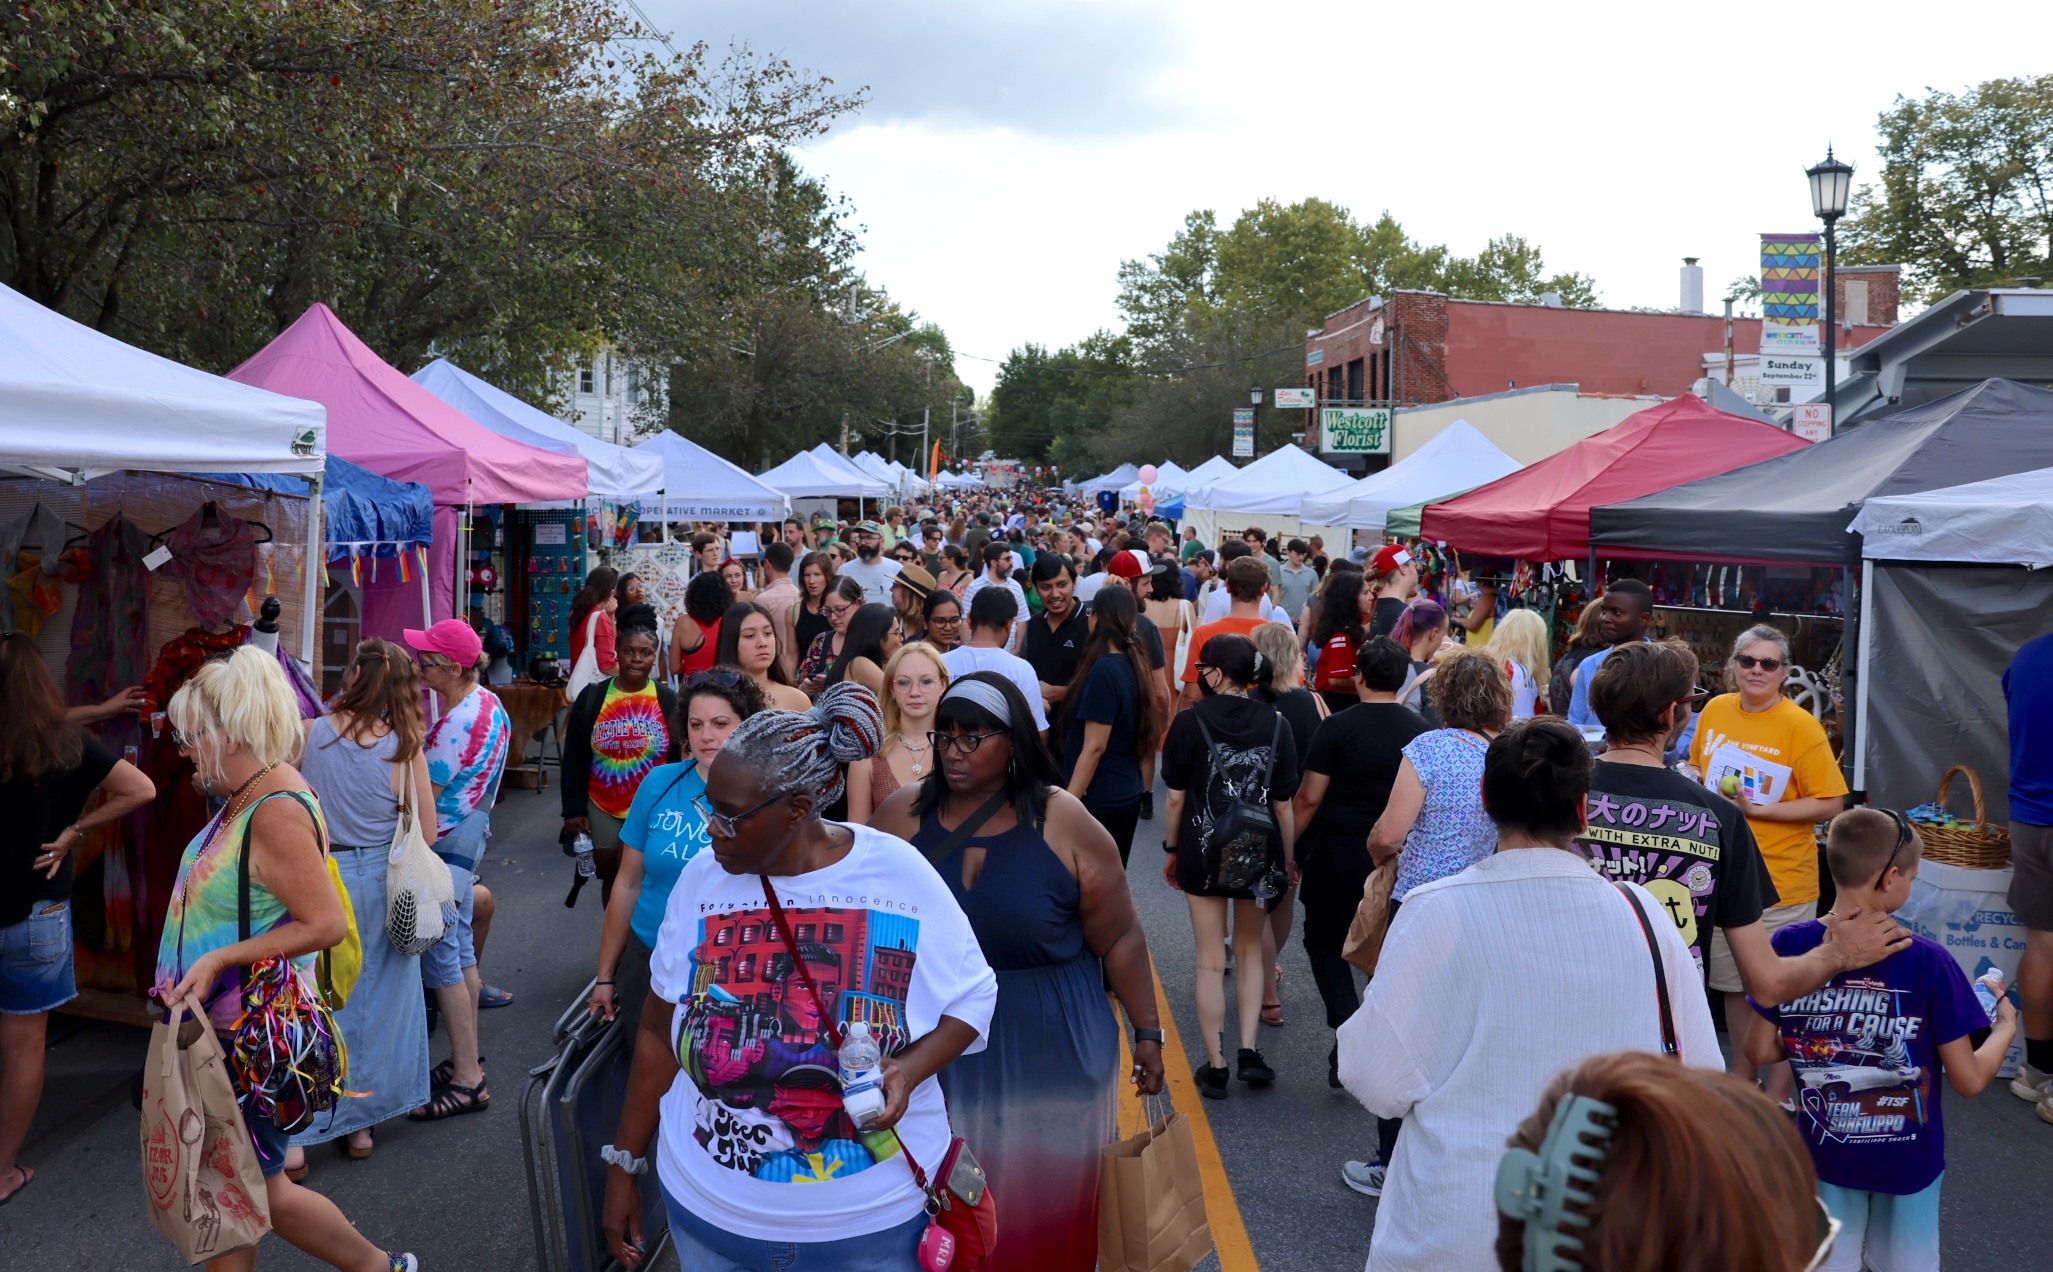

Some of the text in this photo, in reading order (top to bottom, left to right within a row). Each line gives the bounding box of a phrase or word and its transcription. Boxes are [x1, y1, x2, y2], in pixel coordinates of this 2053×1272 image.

[1767, 360, 1812, 371] Sunday
[1326, 411, 1386, 431] Westcott
[1805, 409, 1819, 418] NO
[1332, 430, 1382, 449] Florist
[632, 717, 666, 740] BEACH
[596, 737, 661, 750] SOUTH CAROLINA
[1727, 740, 1781, 756] THE VINEYARD
[661, 842, 703, 861] AL
[1588, 828, 1719, 859] WITH EXTRA NUT!
[701, 894, 918, 914] Forgttn Innocence
[1946, 934, 2027, 950] Bottles & Can
[1779, 988, 1891, 1015] CRASHING
[1805, 1012, 1922, 1040] FOR A CAUSE
[1828, 1102, 1862, 1117] TEAM
[1877, 1096, 1909, 1107] #TSF
[1828, 1114, 1906, 1133] SANFILIPPO
[936, 1235, 951, 1267] MRD
